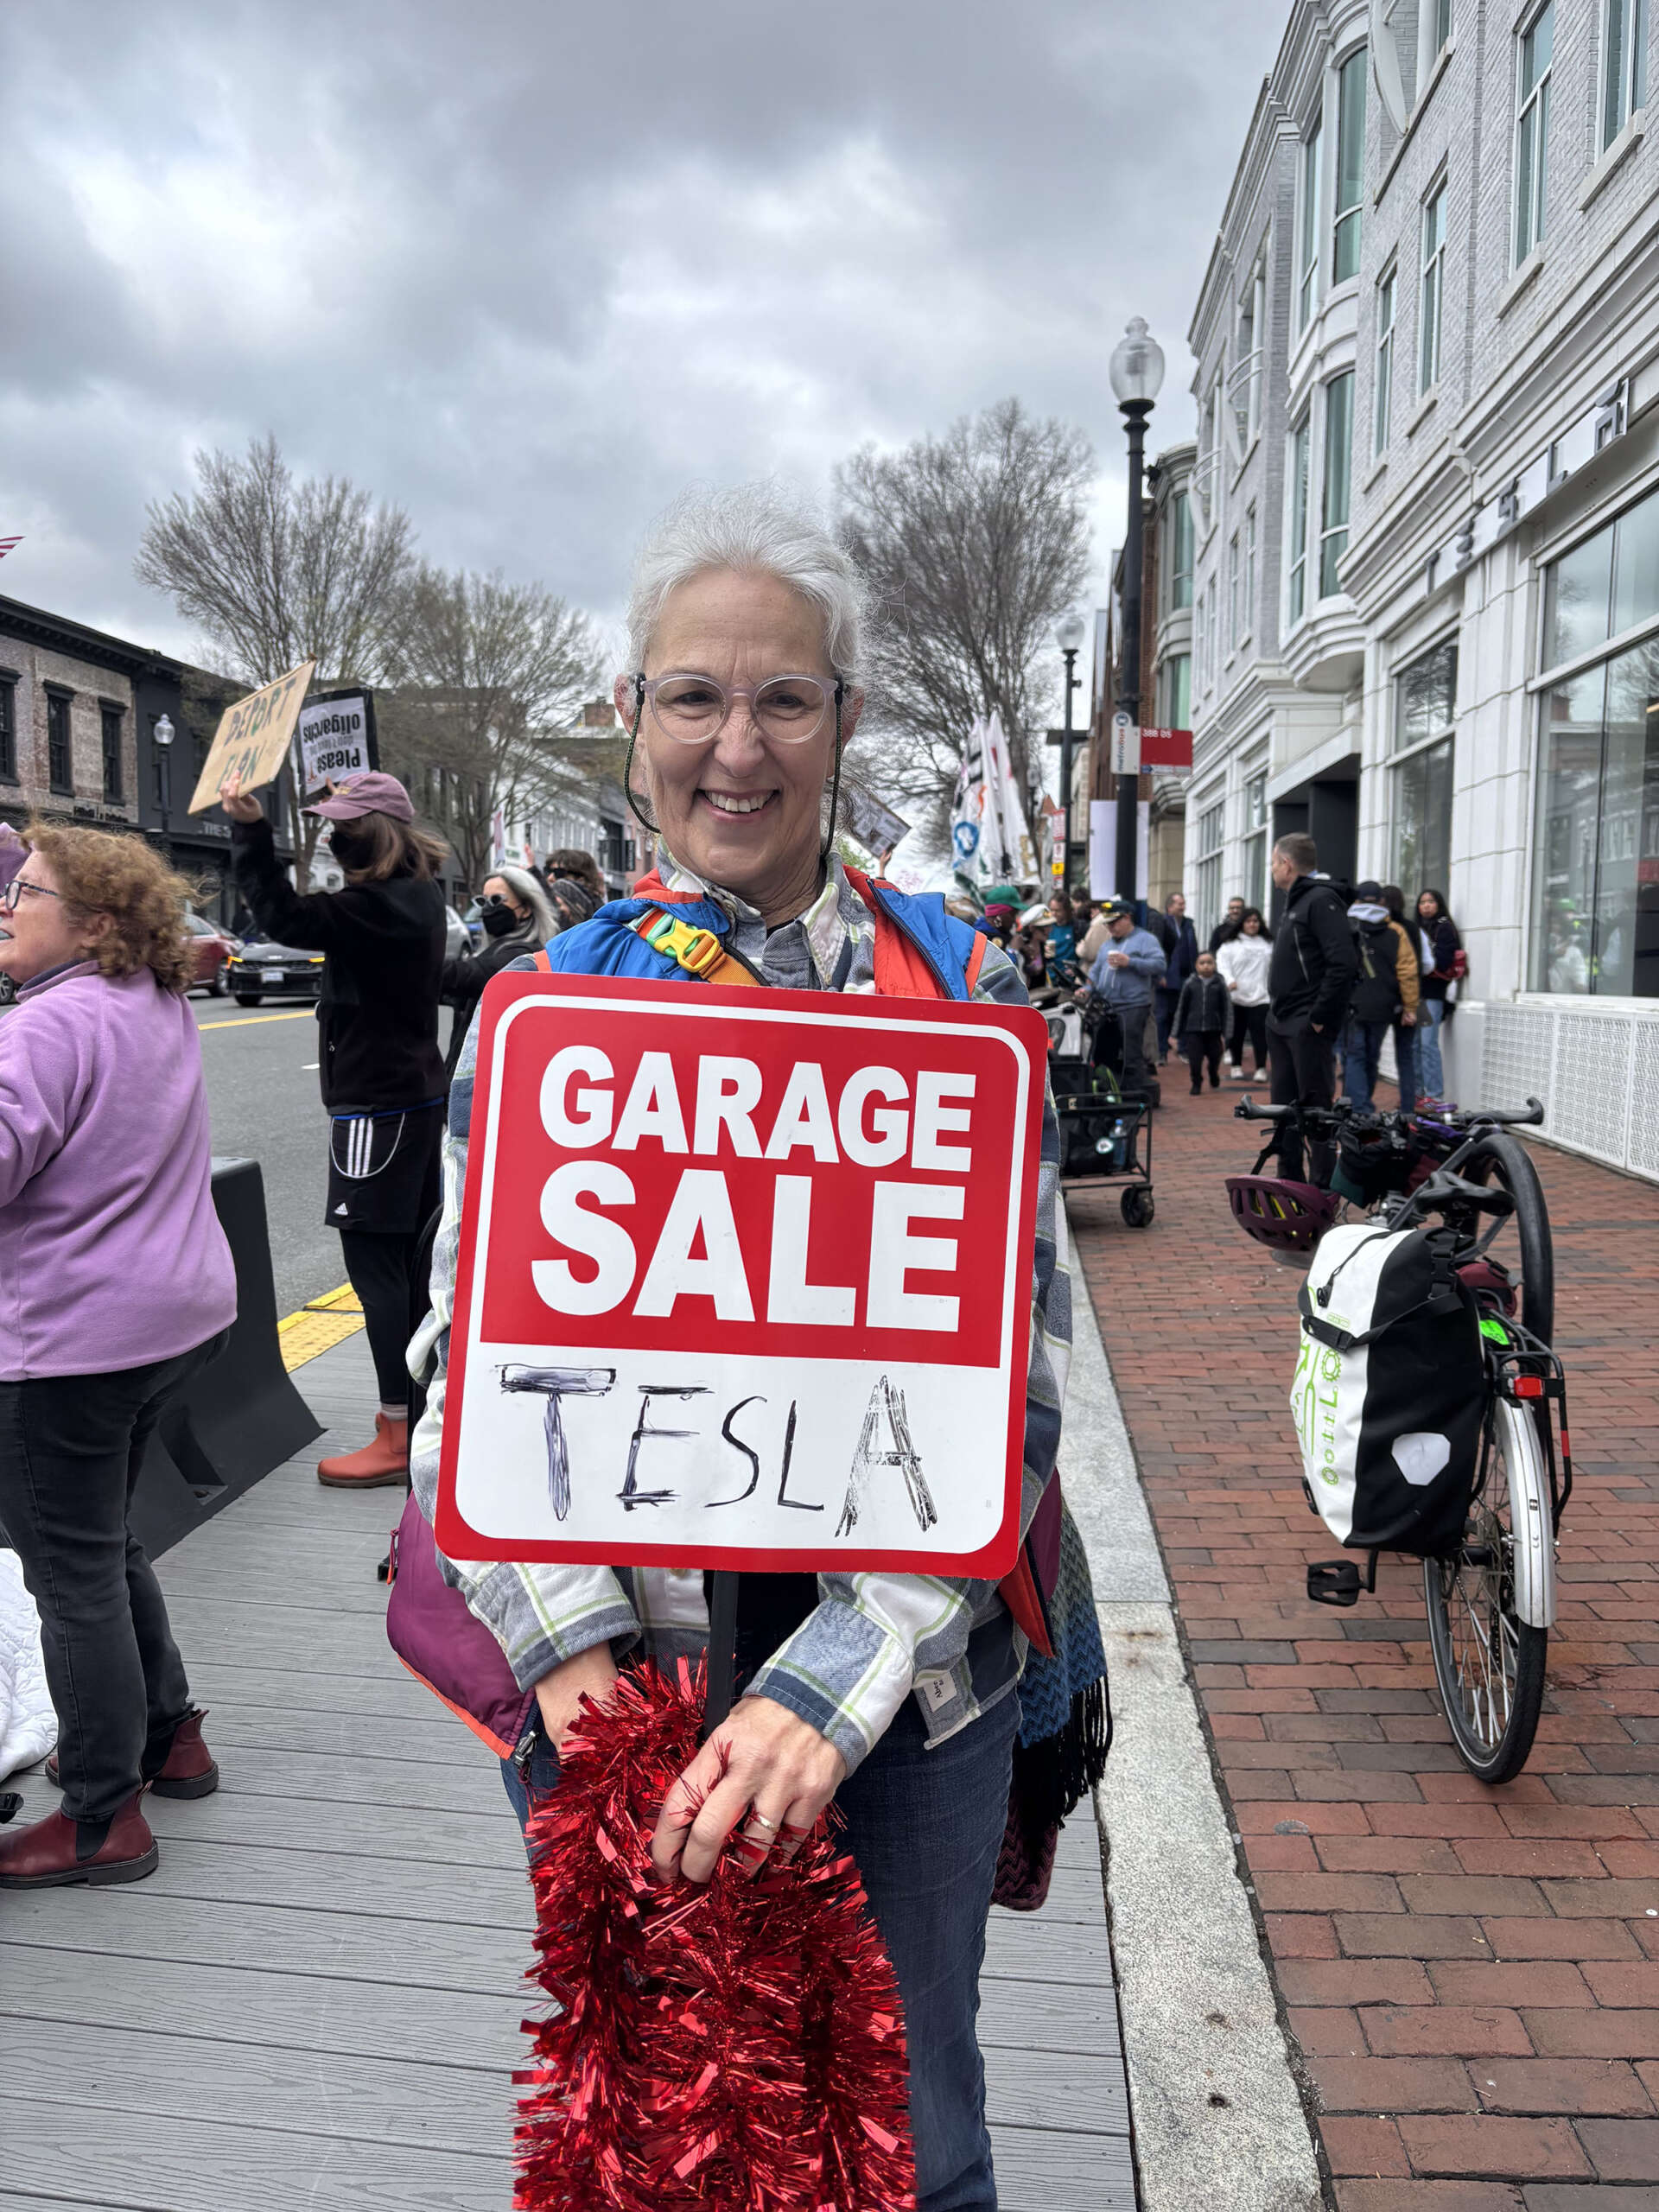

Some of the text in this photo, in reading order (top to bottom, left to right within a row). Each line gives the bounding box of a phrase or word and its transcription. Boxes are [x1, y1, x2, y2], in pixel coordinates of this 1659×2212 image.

[224, 677, 296, 747] DEPORT
[303, 714, 360, 743] oligarchs
[317, 748, 361, 774] Please
[538, 1046, 976, 1173] GARAGE
[531, 1160, 965, 1332] SALE
[495, 1363, 938, 1538] TESLA
